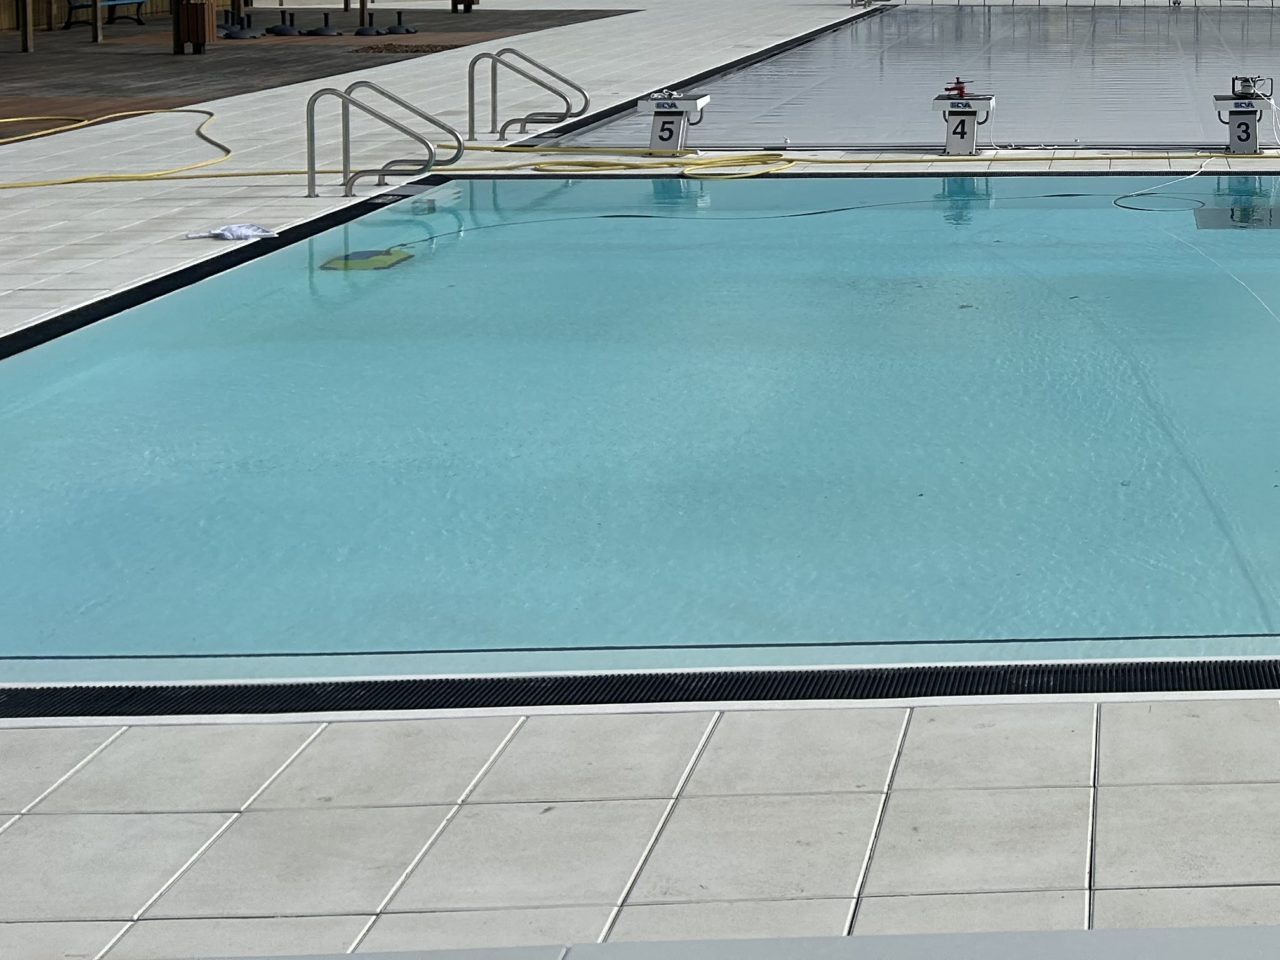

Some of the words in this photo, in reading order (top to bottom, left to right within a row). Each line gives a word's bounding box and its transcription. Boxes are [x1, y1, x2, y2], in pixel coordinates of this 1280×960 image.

[658, 121, 674, 141] 5
[952, 119, 967, 139] 4
[1236, 122, 1251, 142] 3
